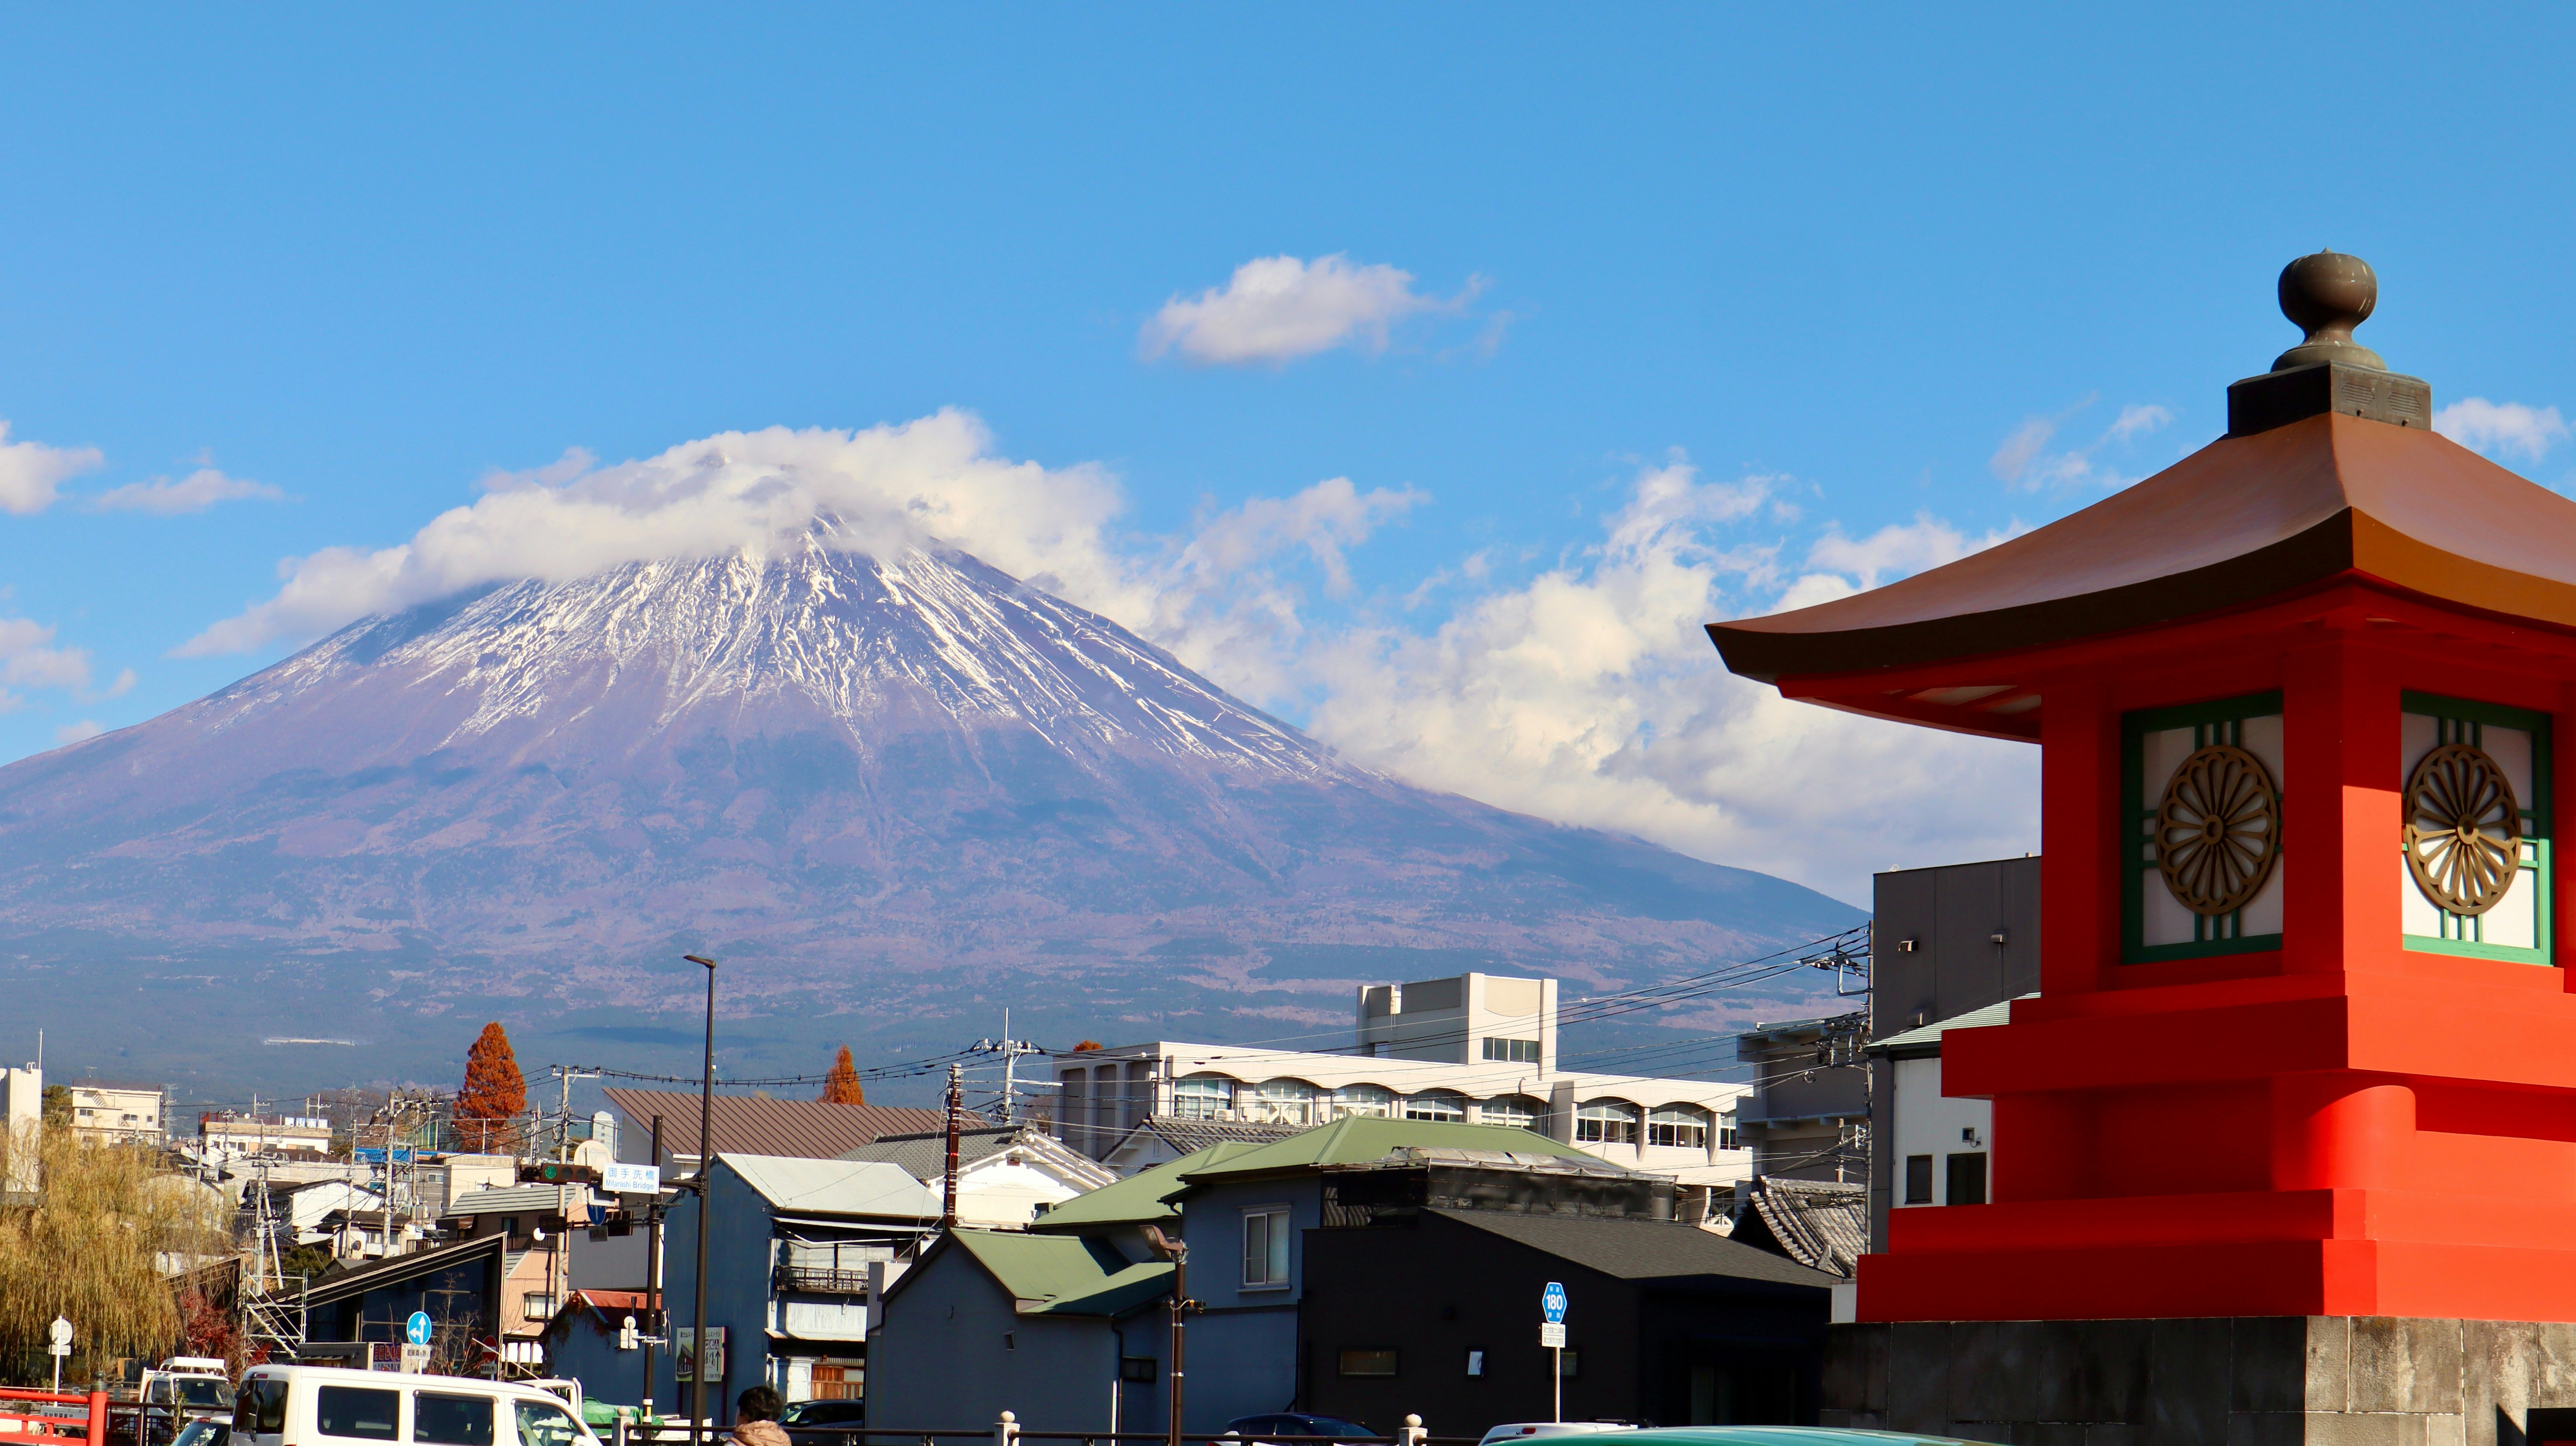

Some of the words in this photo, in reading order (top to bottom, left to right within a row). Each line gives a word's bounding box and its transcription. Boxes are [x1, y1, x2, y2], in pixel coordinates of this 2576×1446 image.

[608, 1167, 655, 1181] 御手洗橋
[606, 1179, 631, 1188] Mitarashi
[633, 1181, 654, 1191] Bridge
[1546, 1294, 1563, 1310] 180
